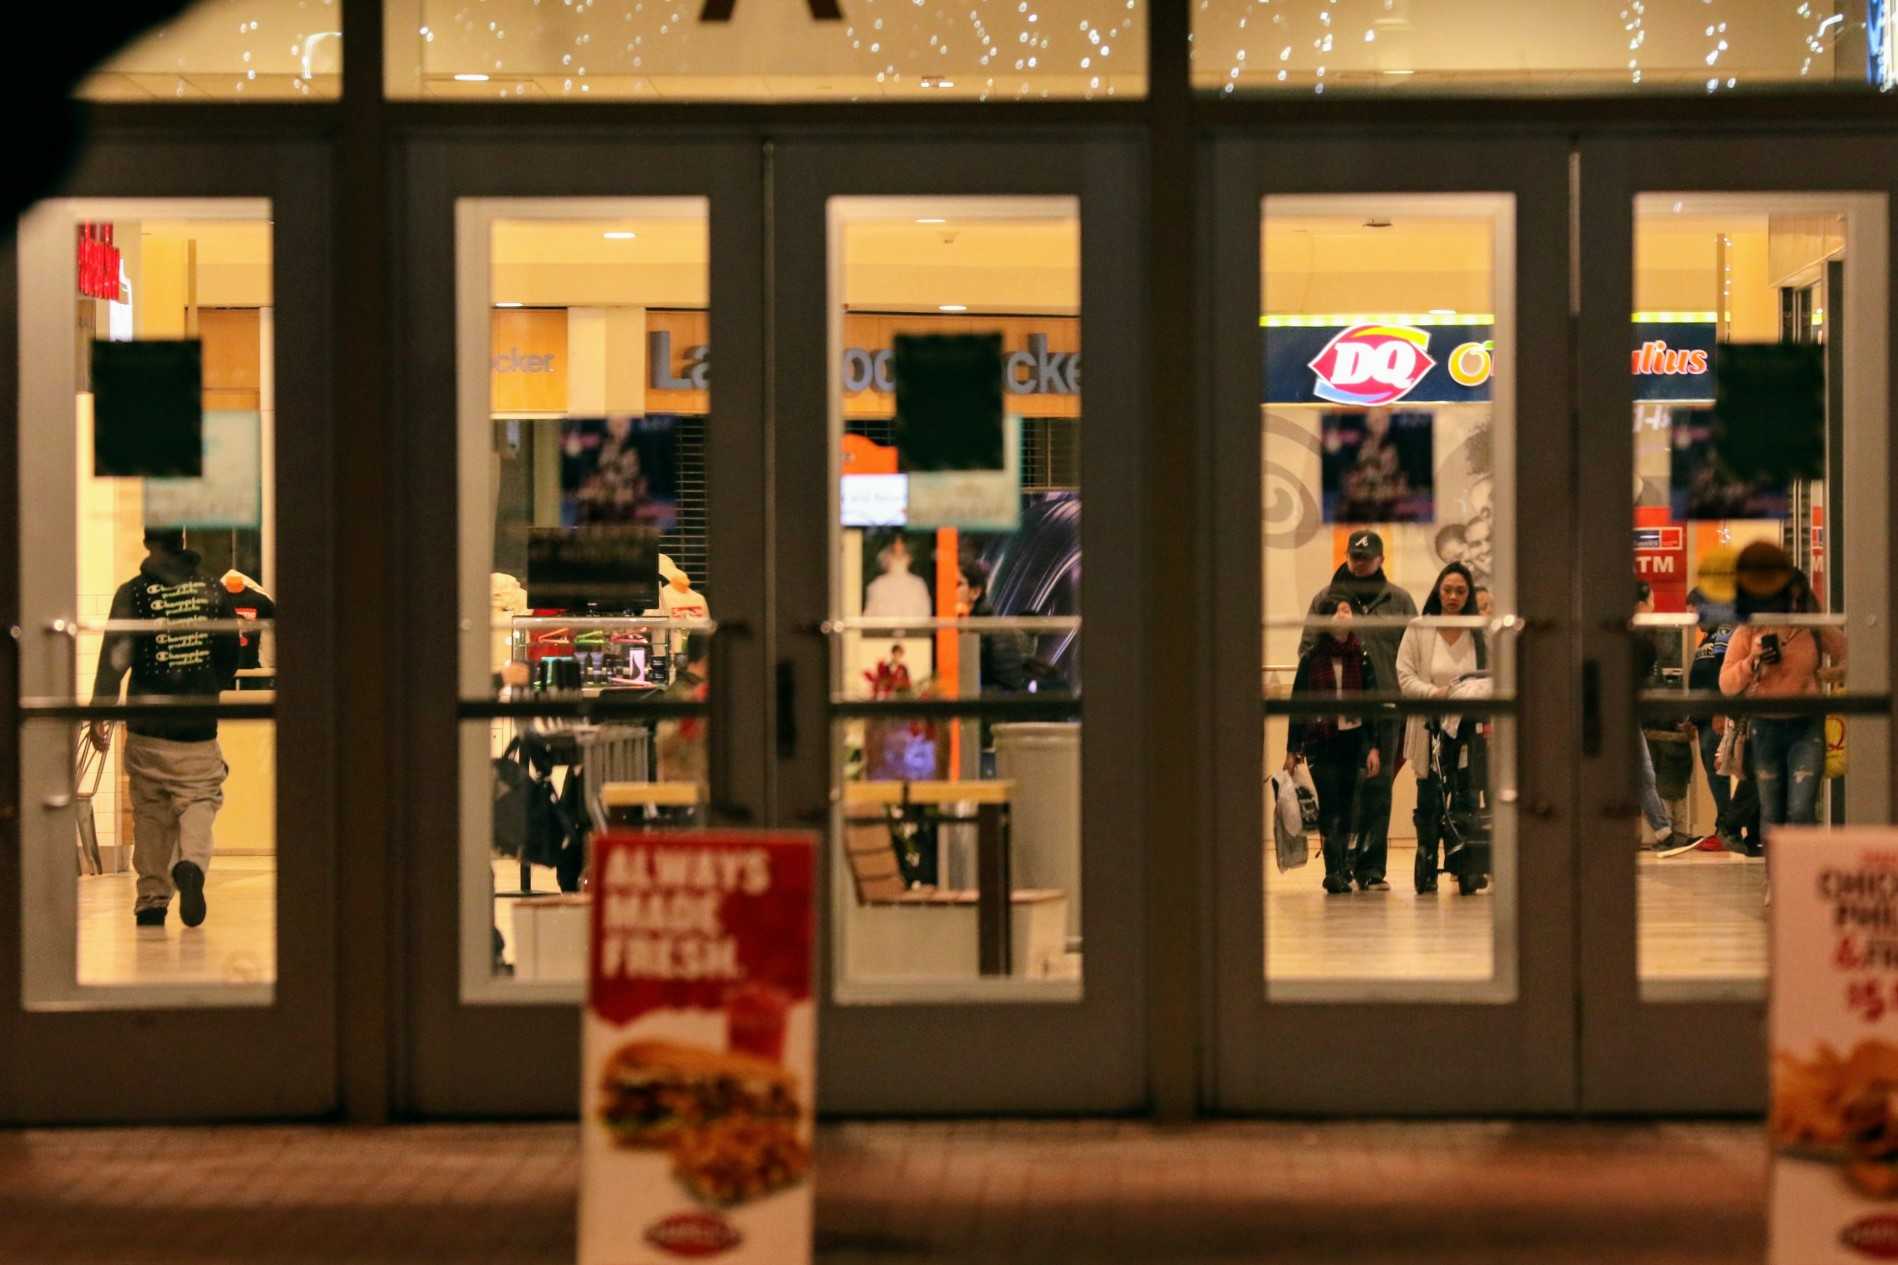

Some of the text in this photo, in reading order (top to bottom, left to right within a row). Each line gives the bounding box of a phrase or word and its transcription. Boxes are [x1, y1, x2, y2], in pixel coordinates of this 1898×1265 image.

[489, 347, 555, 373] cker
[648, 331, 709, 389] La
[1632, 340, 1709, 375] lius
[1635, 555, 1675, 574] TM
[603, 847, 771, 893] ALWAYS
[603, 892, 724, 936] MADE
